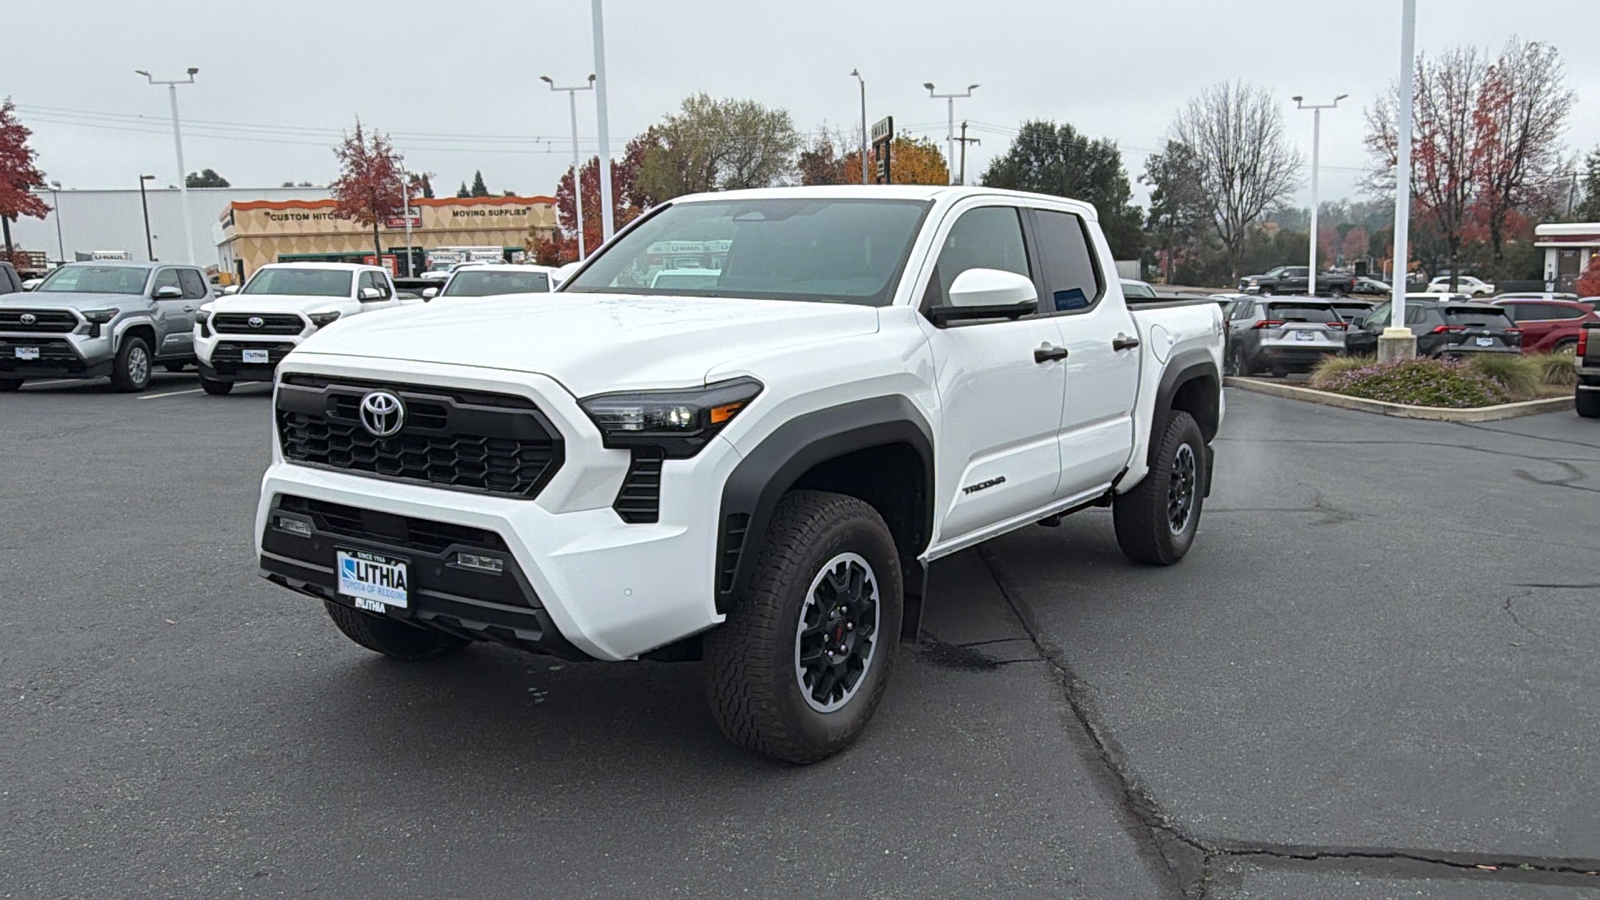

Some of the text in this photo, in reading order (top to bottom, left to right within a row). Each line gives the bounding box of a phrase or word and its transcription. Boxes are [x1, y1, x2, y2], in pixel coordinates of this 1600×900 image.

[270, 213, 310, 221] CUSTOM
[962, 475, 1007, 495] TACOMA
[356, 560, 407, 591] LITHIA
[342, 579, 366, 592] TOYOTA
[367, 585, 376, 594] OF
[362, 598, 386, 613] LITHIA
